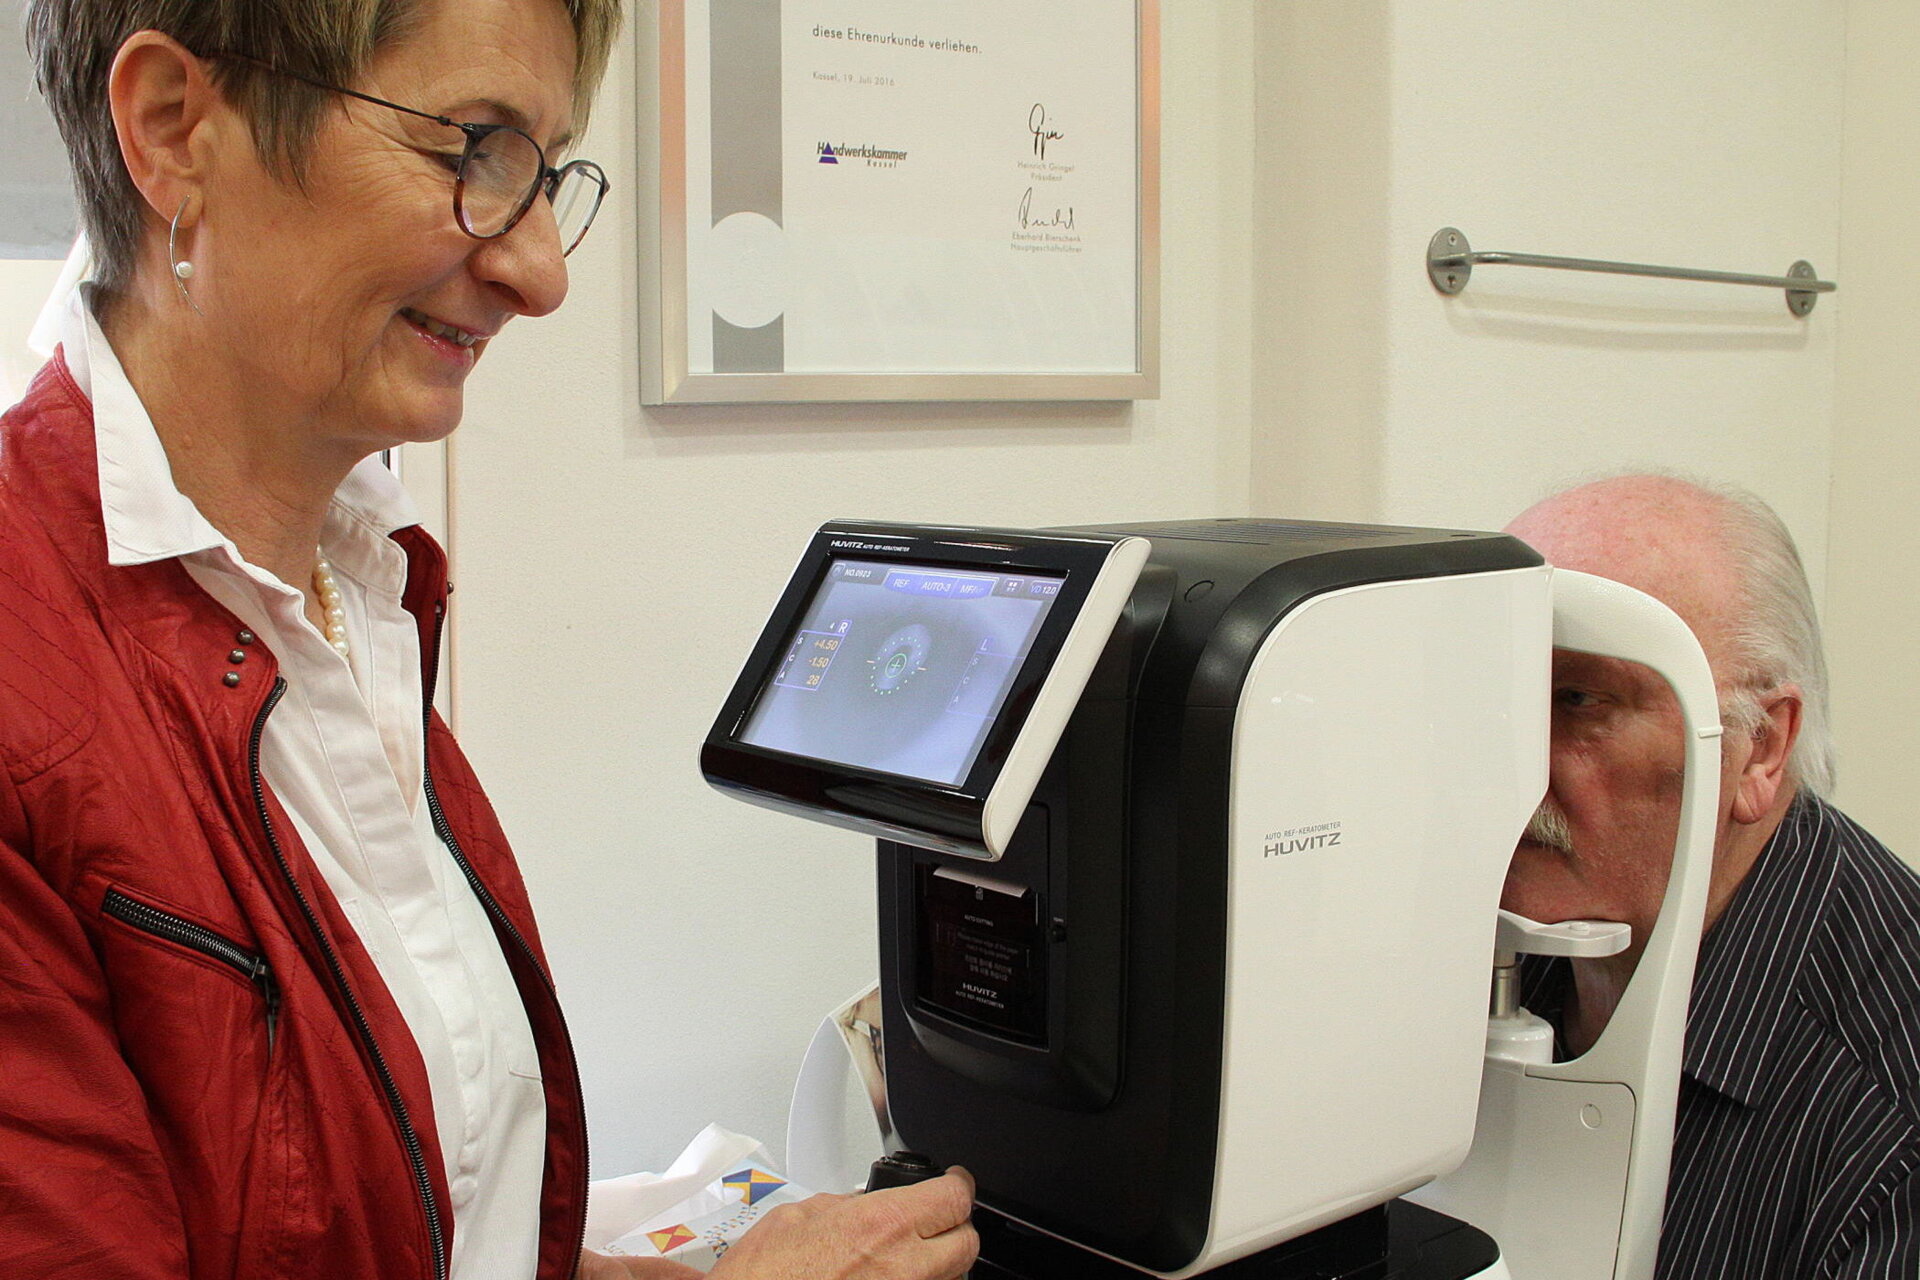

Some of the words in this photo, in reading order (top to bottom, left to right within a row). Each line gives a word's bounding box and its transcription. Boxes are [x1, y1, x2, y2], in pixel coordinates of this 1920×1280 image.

[812, 24, 843, 40] diese
[847, 27, 925, 49] Ehrenurkunde
[929, 37, 983, 55] verliehen.
[812, 71, 841, 82] Kassel,
[875, 76, 895, 87] 2016
[831, 540, 864, 550] HUVITZ
[893, 578, 911, 588] REF
[838, 621, 849, 633] R
[1264, 831, 1282, 841] AUTO
[1284, 821, 1342, 837] REF-KERATOMETER
[1263, 831, 1342, 858] HUVITZ
[962, 982, 998, 999] HUVITZ
